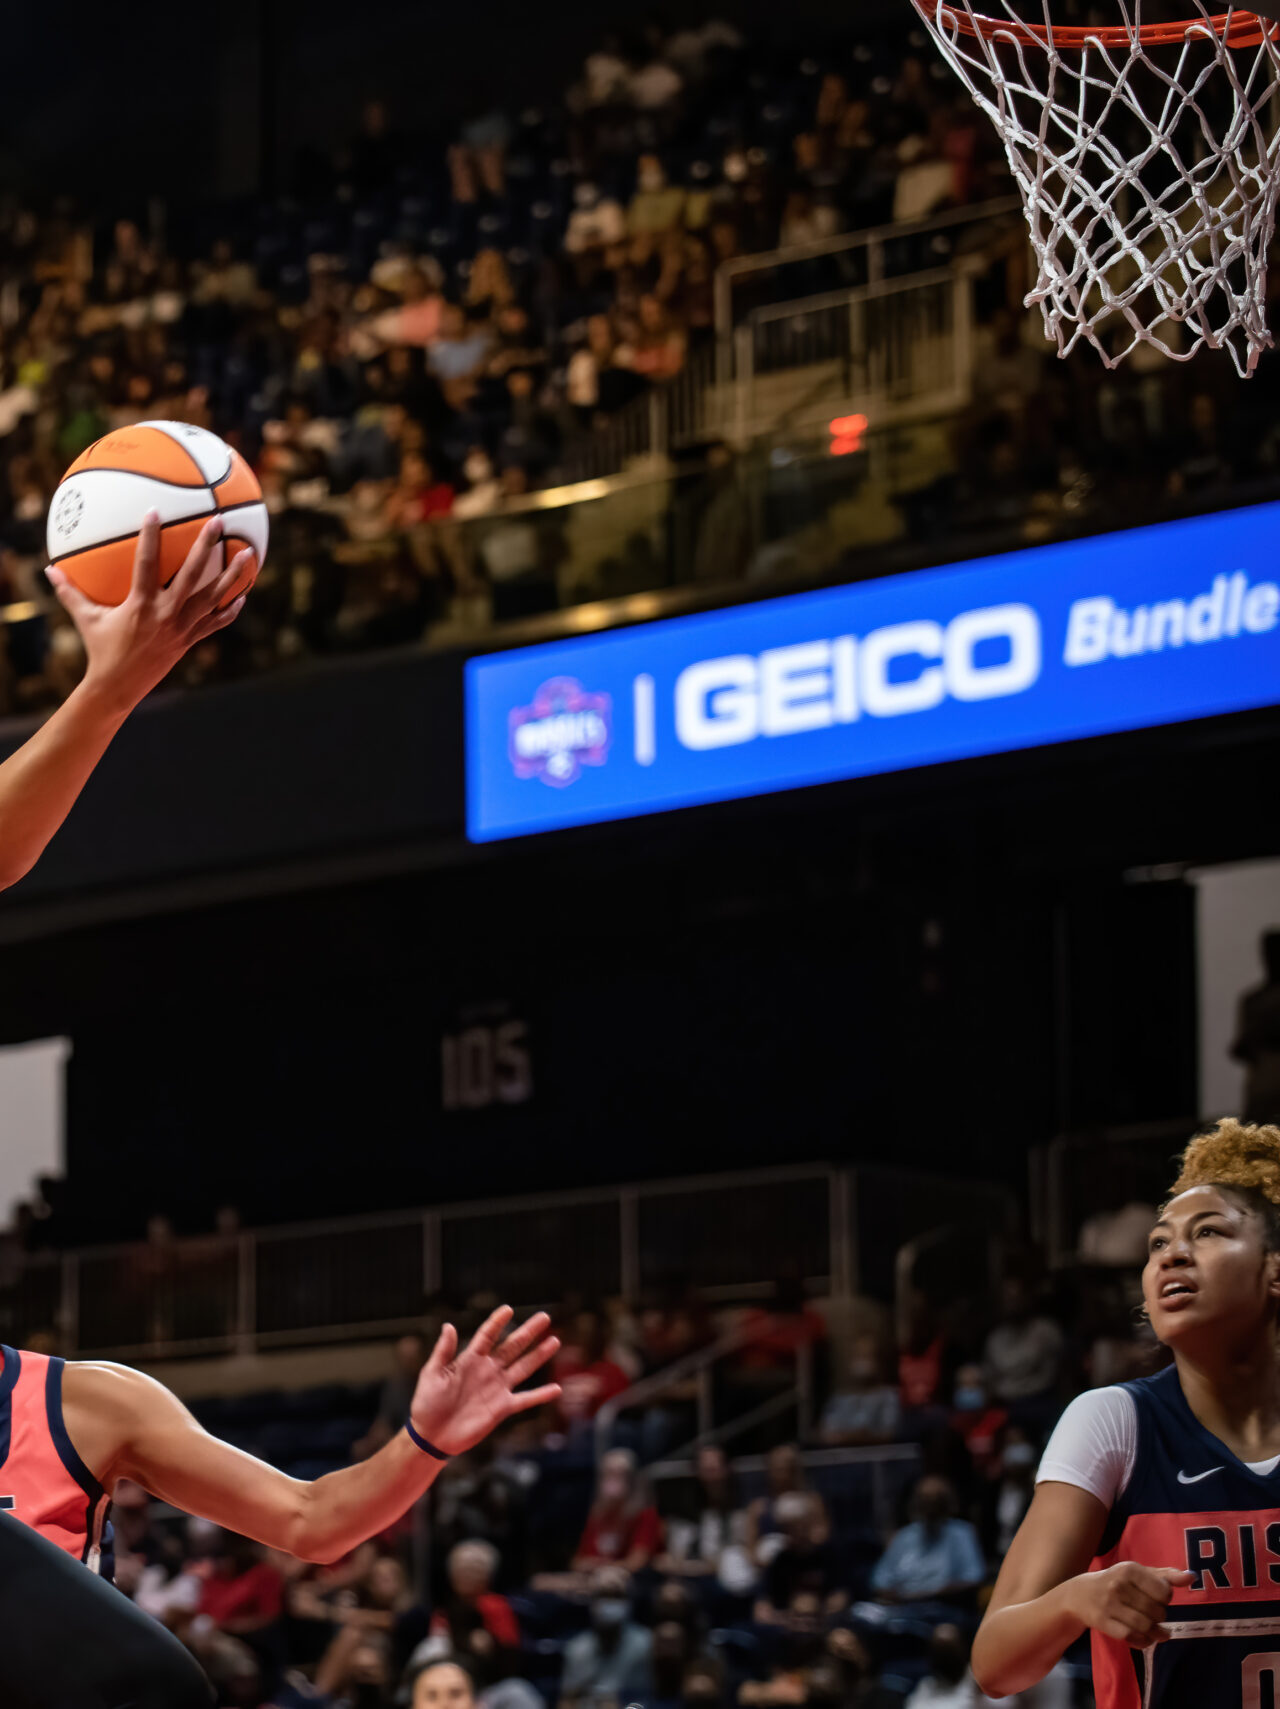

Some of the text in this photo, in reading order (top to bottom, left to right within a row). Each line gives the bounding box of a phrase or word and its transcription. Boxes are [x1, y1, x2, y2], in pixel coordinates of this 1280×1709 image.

[675, 569, 1280, 751] GEICO Bundle
[441, 1019, 535, 1111] 105
